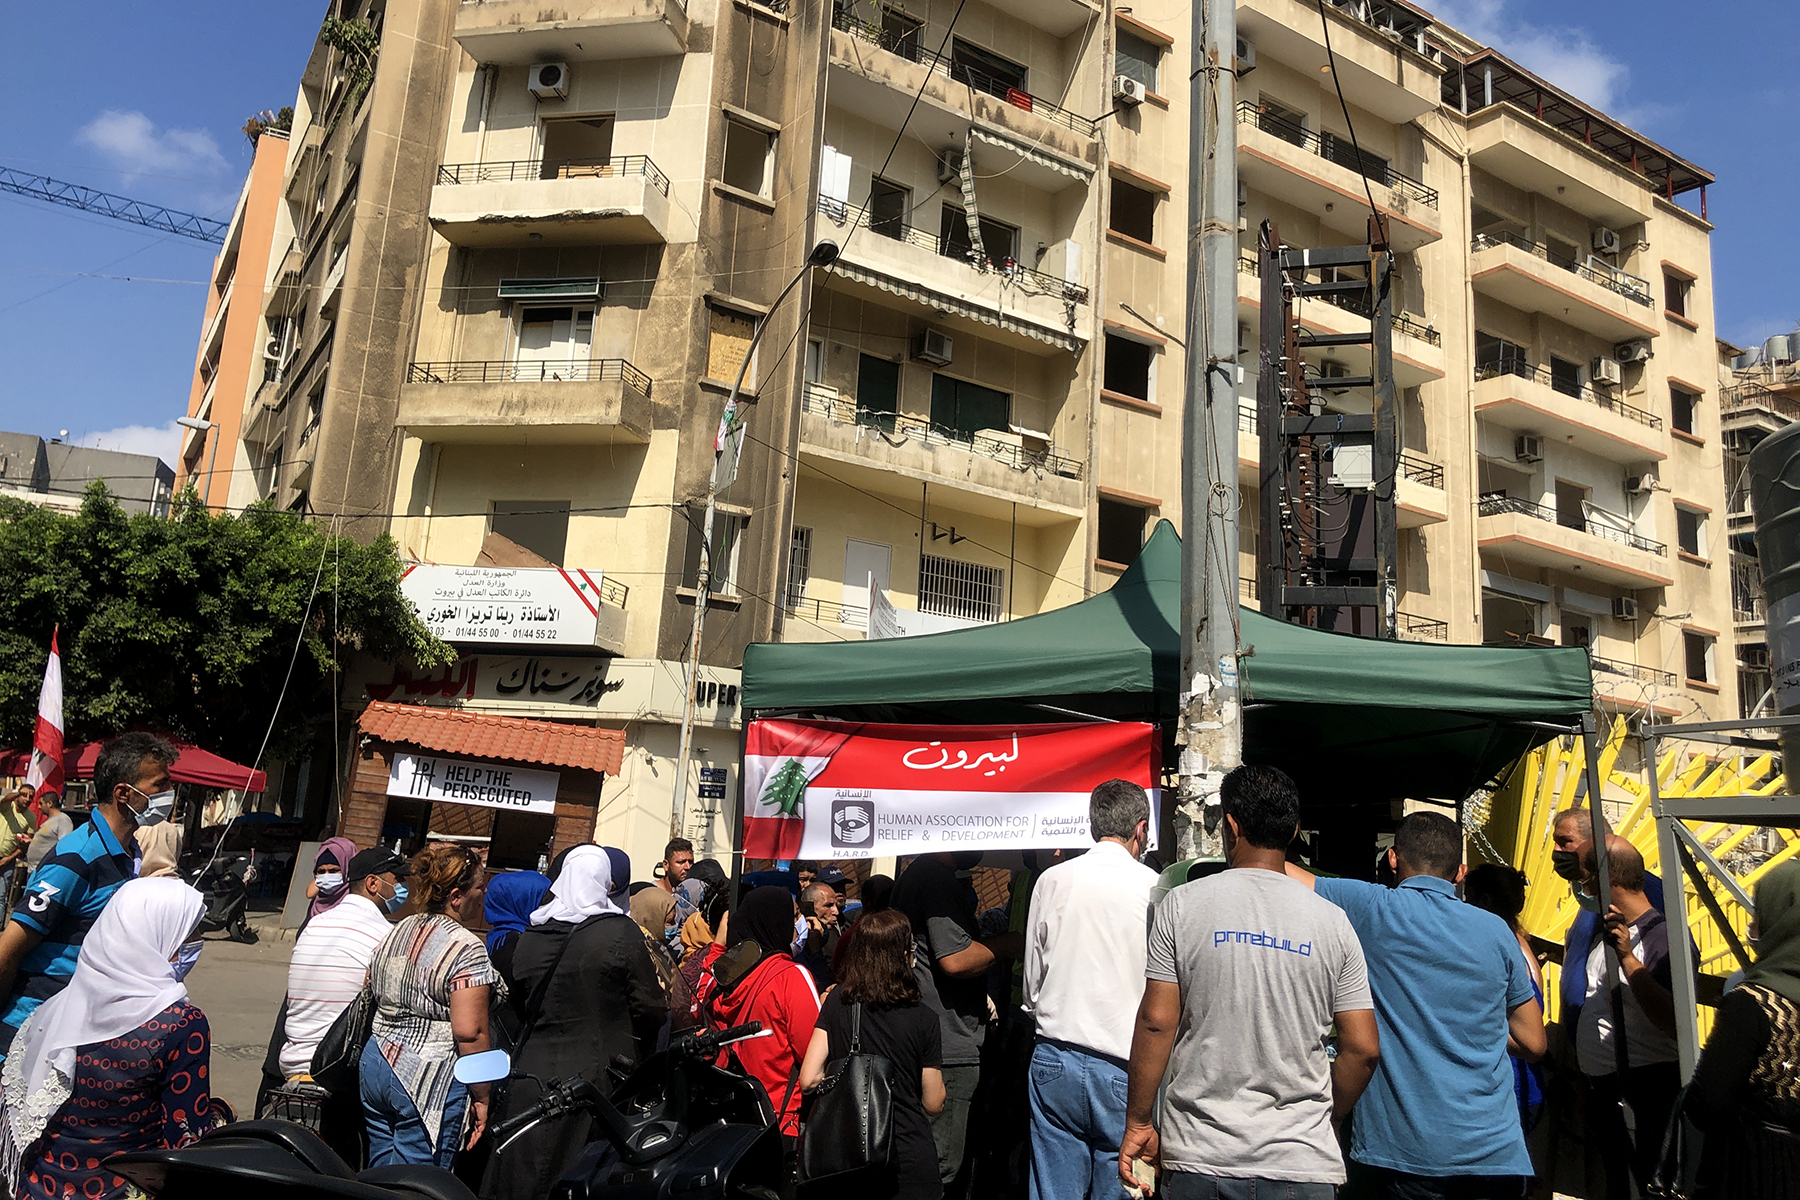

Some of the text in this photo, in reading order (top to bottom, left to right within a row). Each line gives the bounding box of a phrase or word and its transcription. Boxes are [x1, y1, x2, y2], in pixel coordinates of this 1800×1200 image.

[454, 568, 517, 579] الجمهورية اللبنانية
[462, 579, 506, 588] وزارة العدل
[434, 587, 532, 600] دائرة الكاتب العدل في بيروت
[426, 604, 461, 625] الخوري
[465, 605, 493, 625] تريزا
[496, 606, 514, 626] ريتا
[520, 604, 560, 622] الأستاذة
[435, 626, 445, 636] 03
[455, 626, 476, 637] 01/44
[478, 627, 488, 637] 55
[489, 628, 500, 638] 00
[512, 628, 534, 639] 01/44
[535, 629, 546, 639] 55
[547, 629, 557, 639] 22
[696, 681, 737, 708] UPER
[902, 731, 1018, 777] لبيروت
[445, 765, 482, 783] HELP
[486, 769, 513, 787] THE
[442, 782, 532, 806] PERSECUTED
[835, 789, 872, 801] الإنسانية
[877, 813, 1029, 827] HUMAN ASSOCIATION FOR
[1041, 815, 1084, 827] الإنسانية
[877, 828, 1027, 842] RELIEF & DEVELOPMENT
[1041, 826, 1077, 837] التنمية
[28, 880, 61, 912] 3
